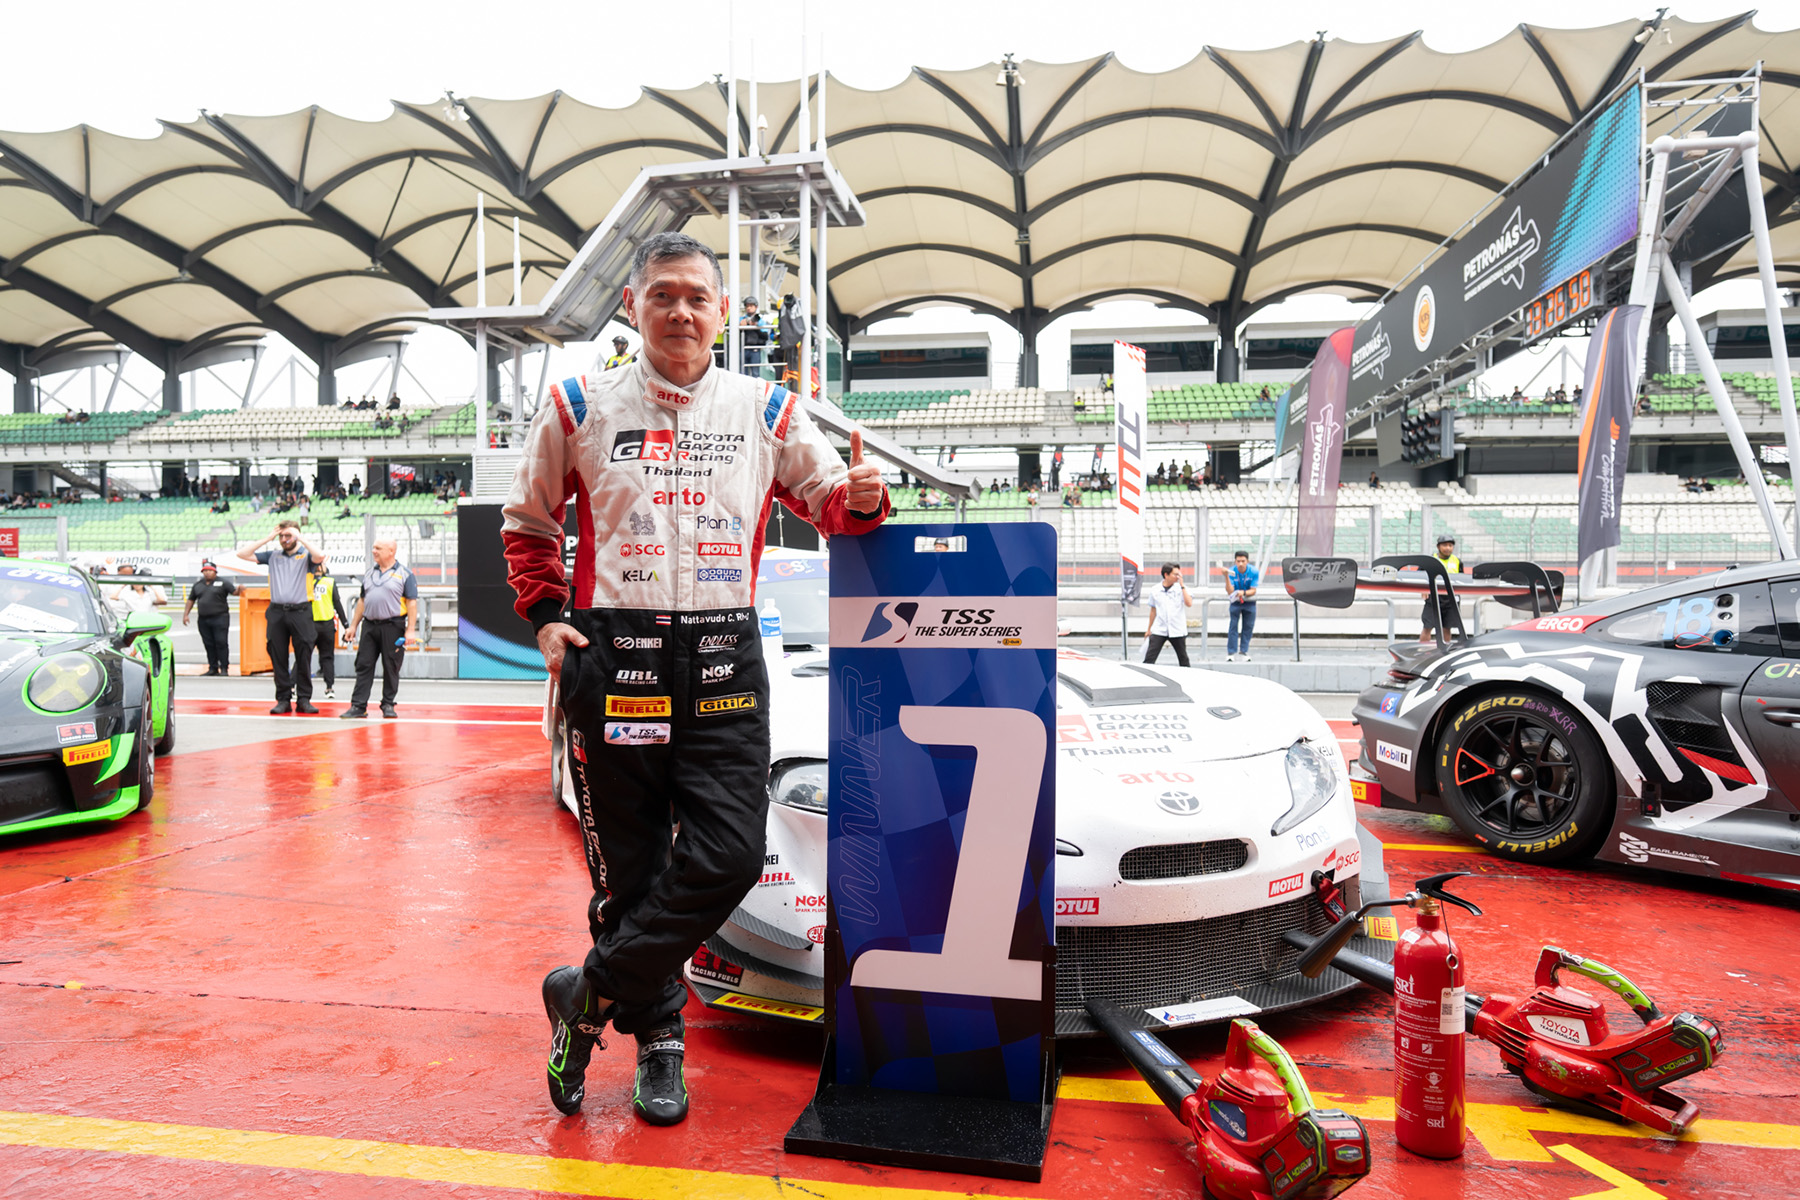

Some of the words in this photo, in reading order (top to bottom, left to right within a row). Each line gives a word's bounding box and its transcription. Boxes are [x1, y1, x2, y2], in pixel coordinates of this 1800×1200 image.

[1463, 224, 1520, 282] PETRONAS
[656, 389, 690, 405] arto
[680, 430, 745, 442] TOYOTA
[612, 440, 671, 460] GR
[677, 440, 738, 452] GAZOO
[677, 451, 735, 464] Racing
[1309, 424, 1325, 496] PETRONAS
[642, 466, 712, 477] Thailand
[653, 487, 705, 506] arto
[635, 544, 665, 556] SCG
[700, 543, 740, 555] MOTUL
[623, 570, 659, 582] KELA
[680, 613, 726, 624] Nattavude
[941, 609, 995, 625] TSS
[1536, 616, 1585, 631] ERGO
[1656, 597, 1714, 640] 18
[915, 626, 938, 636] THE
[939, 626, 979, 636] SUPER
[979, 626, 1022, 637] SERIES
[636, 638, 662, 649] ENKEI
[699, 634, 739, 646] ENDLESS
[616, 669, 658, 680] DRL
[702, 663, 734, 679] NGK
[611, 699, 667, 713] PIRELLI
[703, 700, 735, 711] Giti
[1089, 713, 1189, 721] TOYOTA
[59, 723, 96, 737] ETS
[1096, 722, 1187, 730] GAZOO
[1100, 731, 1193, 742] Racing
[69, 743, 108, 762] PIRELLI
[1060, 745, 1172, 756] Thailand
[1379, 745, 1400, 761] Mobil
[1117, 770, 1195, 784] arto
[576, 764, 595, 828] TOYOTA
[839, 665, 881, 926] WINNER
[1497, 821, 1578, 854] PIRELLI
[850, 705, 1047, 1001] 1
[1344, 850, 1360, 866] SCG
[758, 872, 795, 884] DRL
[1271, 874, 1303, 897] MOTUL
[795, 895, 826, 907] NGK
[1056, 899, 1097, 913] OTUL
[718, 973, 739, 984] FUELS
[1395, 975, 1415, 995] SRI
[724, 996, 815, 1017] PIRELLI
[1540, 1024, 1554, 1033] TEAM
[1554, 1028, 1580, 1044] THAILAND
[1541, 1017, 1580, 1040] TOYOTA
[1427, 1116, 1445, 1128] SRI
